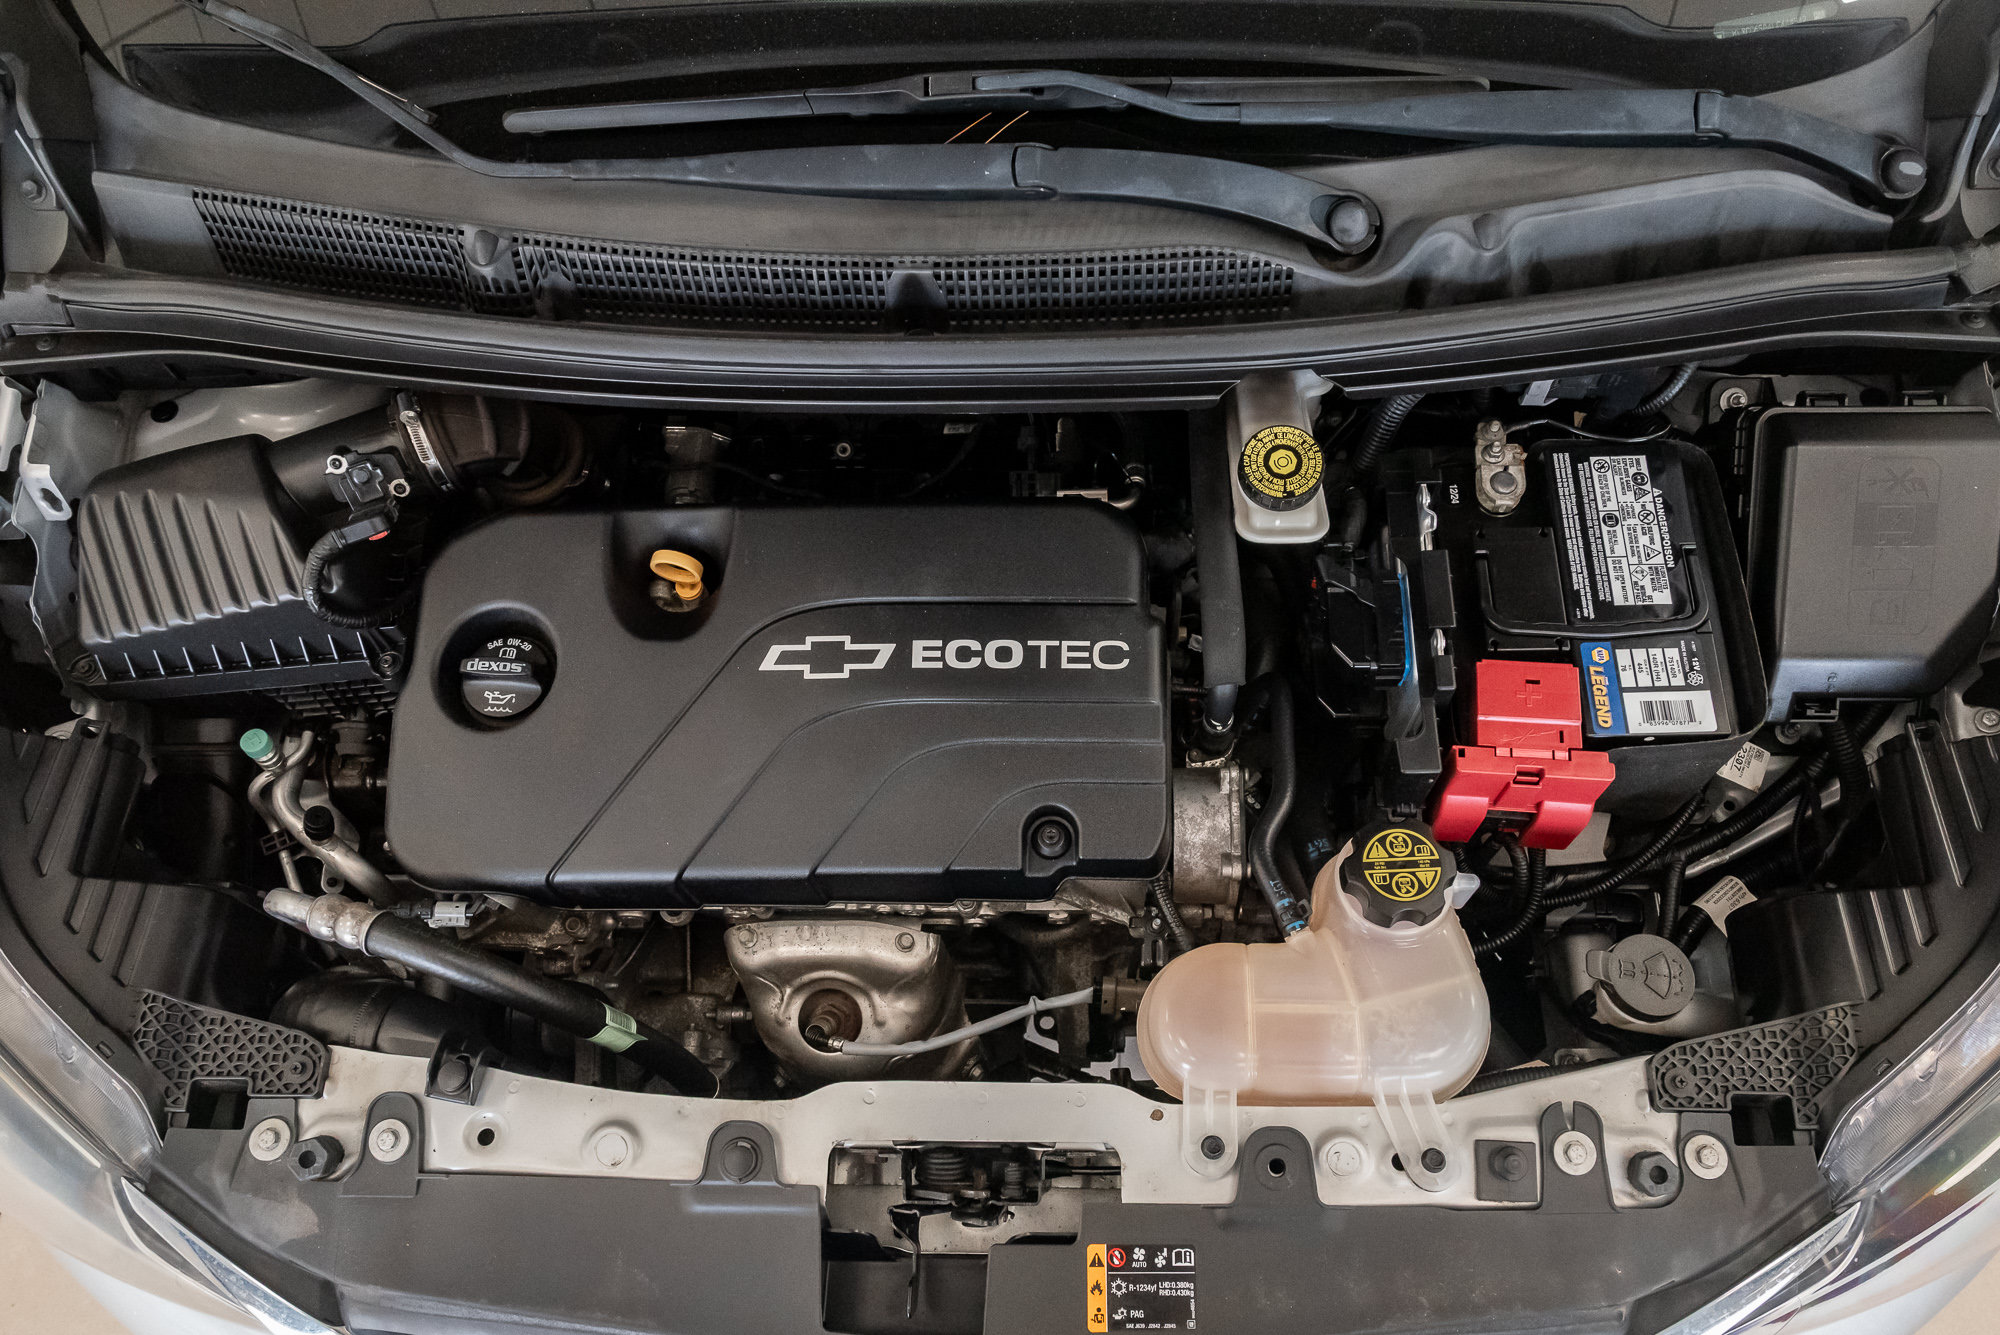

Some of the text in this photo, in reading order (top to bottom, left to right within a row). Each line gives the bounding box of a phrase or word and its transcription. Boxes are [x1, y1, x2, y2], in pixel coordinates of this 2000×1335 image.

[1654, 497, 1674, 567] DANGER/POISON
[487, 638, 532, 652] SAE 0W-20
[912, 639, 1130, 670] ECOTEC
[1596, 649, 1605, 660] NAPA
[466, 658, 522, 673] dexos
[1636, 662, 1644, 673] 445
[1650, 653, 1661, 681] 140R (H4)
[1667, 656, 1677, 678] 75140R
[1691, 657, 1700, 670] 12V
[1589, 666, 1612, 728] LEGEND
[1734, 747, 1747, 771] 2307
[1129, 1284, 1157, 1293] R-1234yf
[1130, 1310, 1144, 1318] PAG
